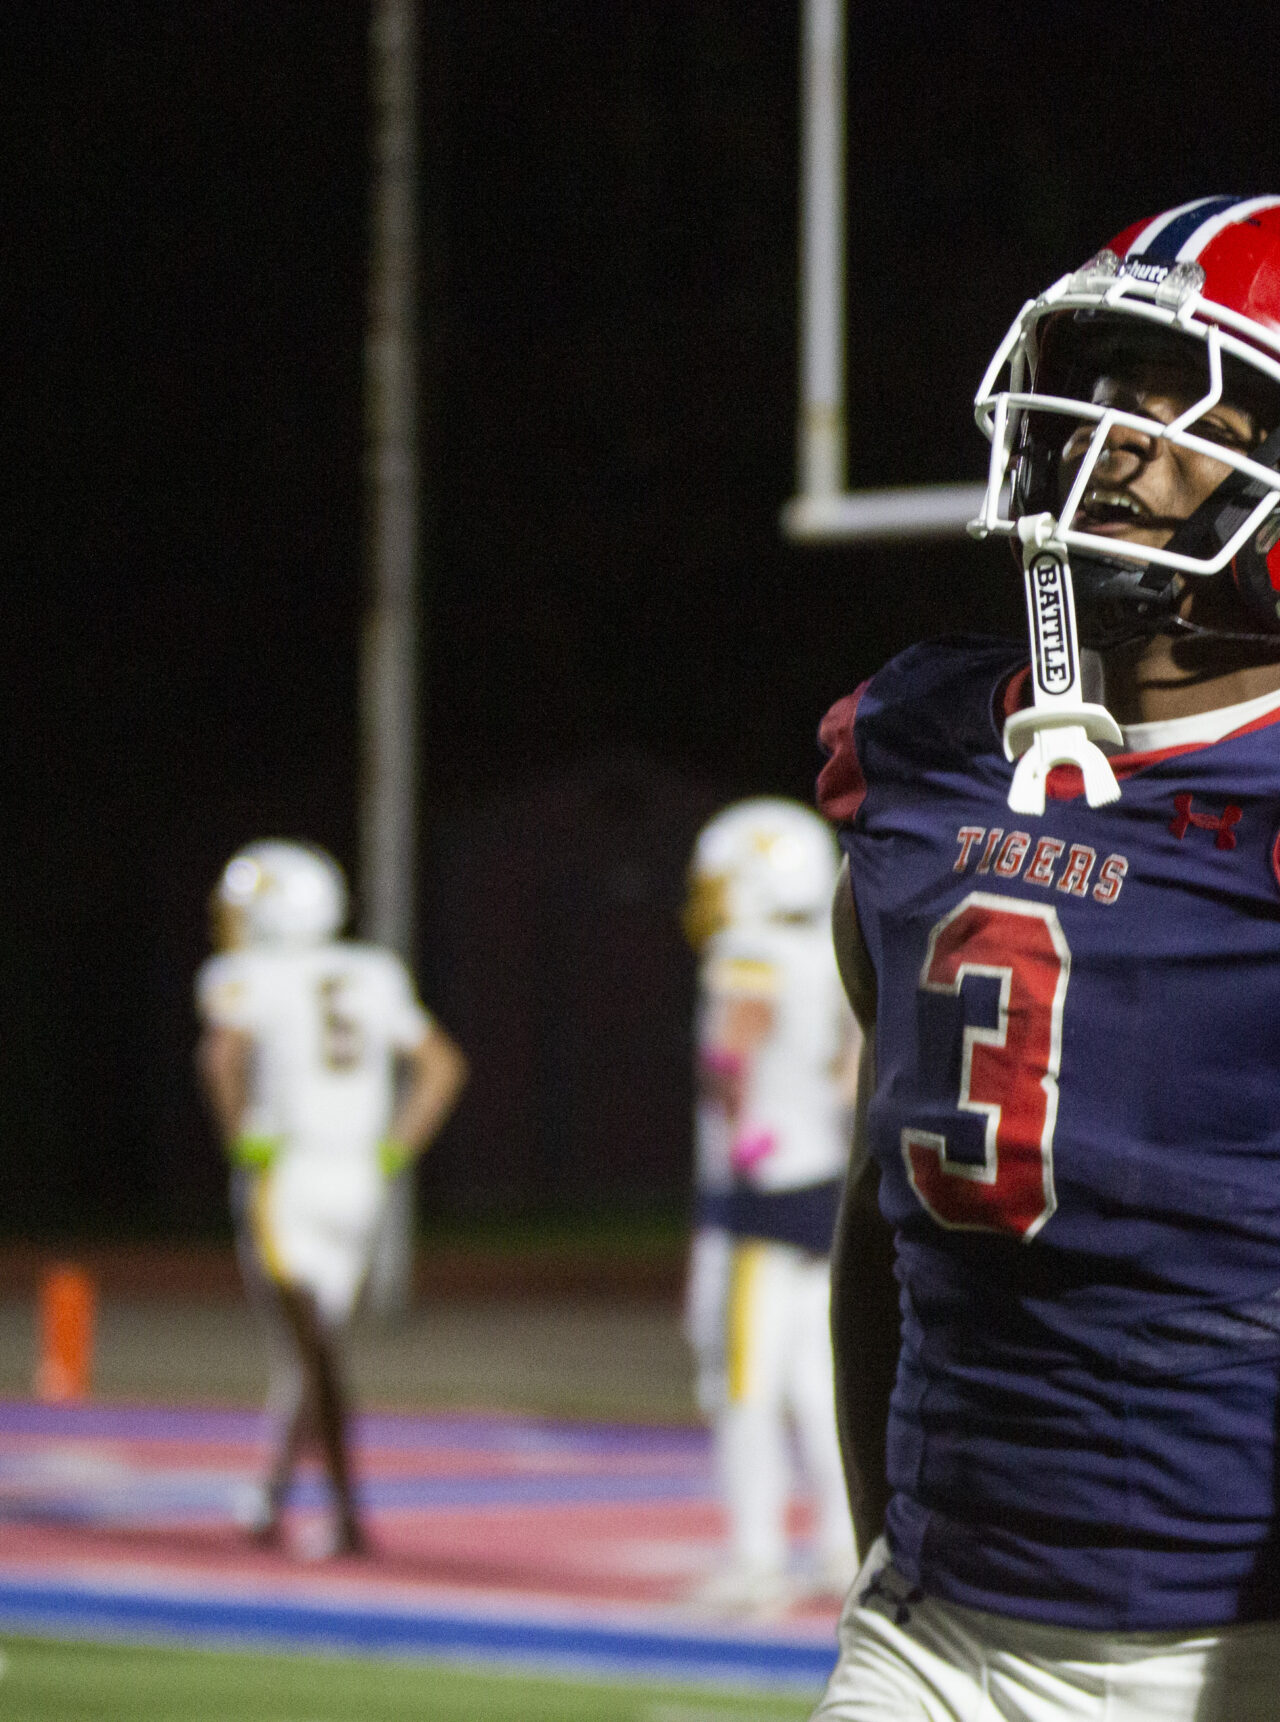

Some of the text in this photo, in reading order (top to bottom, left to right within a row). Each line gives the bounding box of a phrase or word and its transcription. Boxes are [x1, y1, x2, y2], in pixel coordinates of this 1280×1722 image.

[1037, 563, 1067, 682] BATTLE
[953, 826, 1129, 904] TIGERS
[902, 891, 1071, 1245] 3
